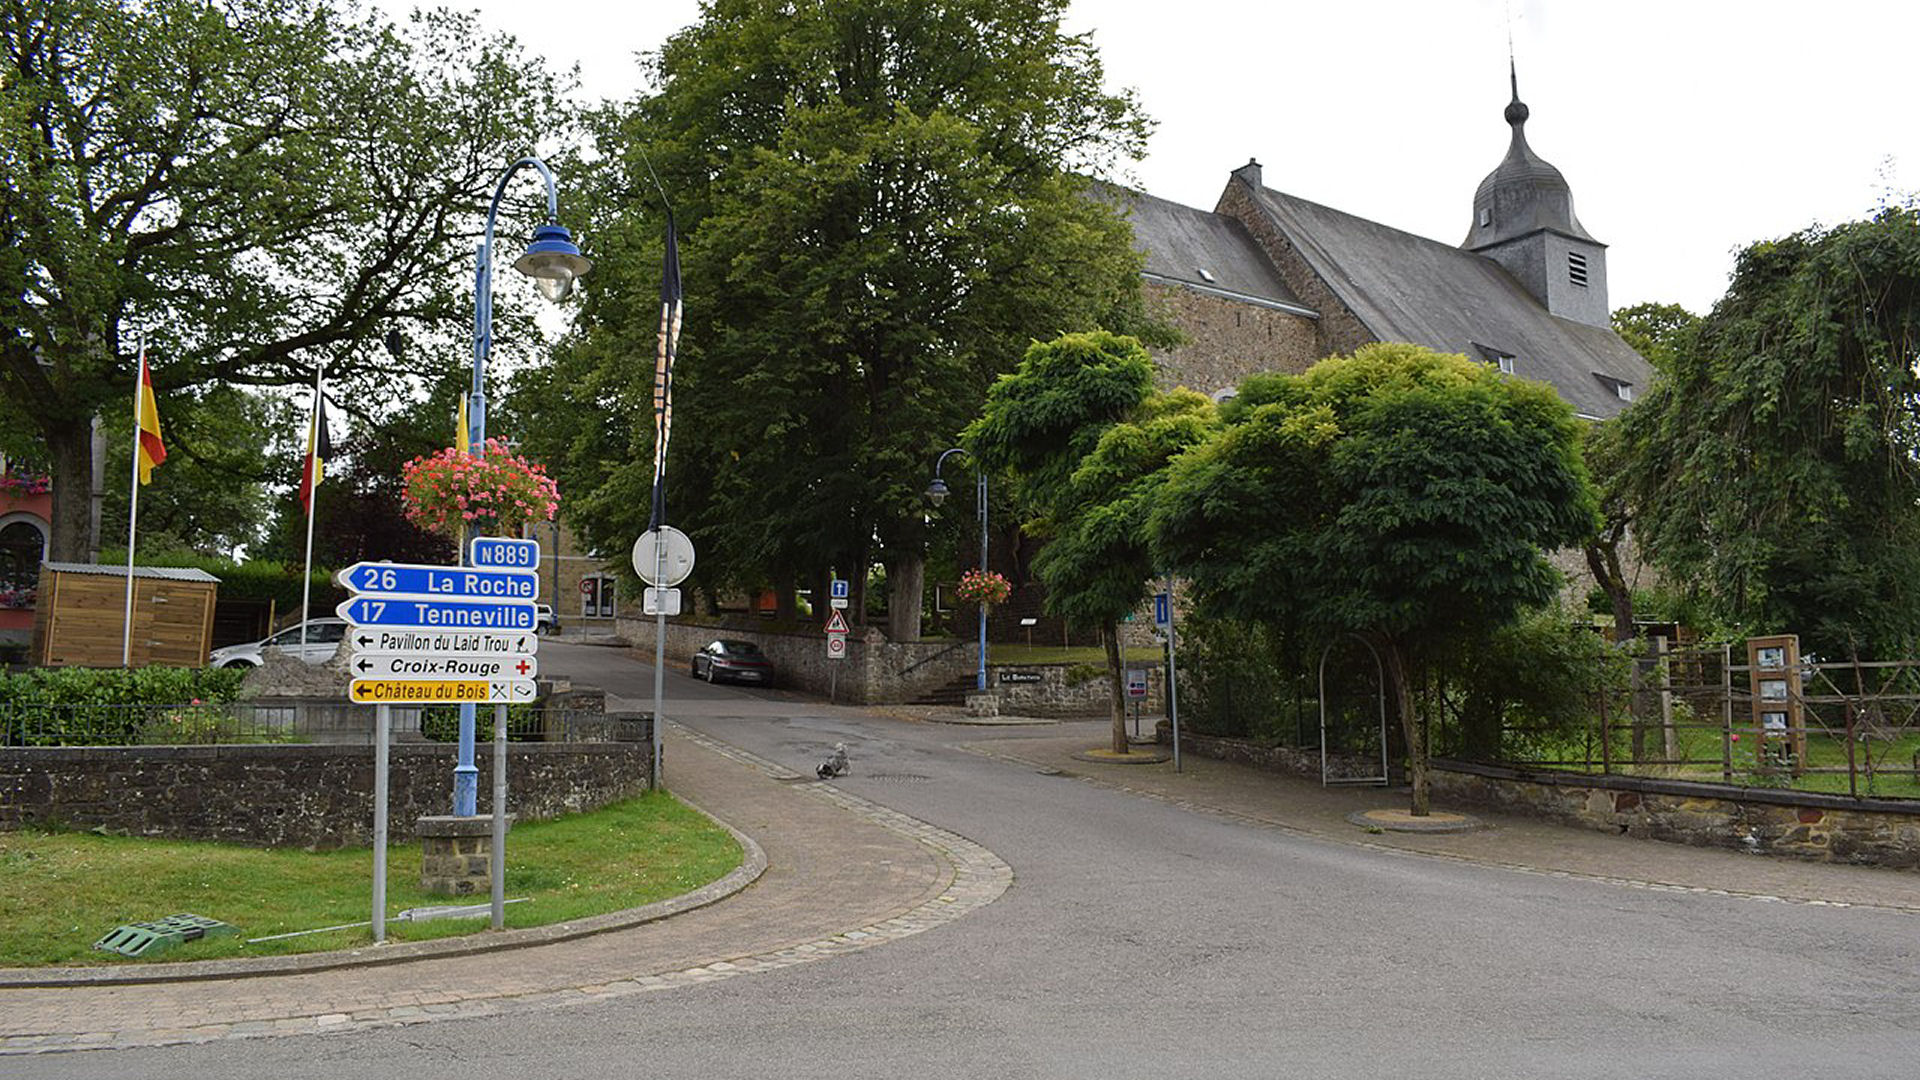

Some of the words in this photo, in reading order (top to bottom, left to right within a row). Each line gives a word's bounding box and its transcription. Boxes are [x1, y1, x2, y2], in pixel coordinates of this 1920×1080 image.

[482, 545, 529, 565] N889
[364, 569, 397, 590] 26
[428, 572, 454, 593] La
[465, 574, 532, 596] Roche
[361, 602, 386, 623] 17
[414, 604, 530, 627] Tenneville
[380, 633, 430, 650] Pavillon
[434, 634, 450, 650] du
[453, 635, 481, 651] Laid
[484, 635, 510, 652] Trou
[390, 659, 501, 677] Croix-Rouge
[374, 682, 432, 699] Château
[435, 684, 453, 699] du
[456, 684, 487, 699] Bois
